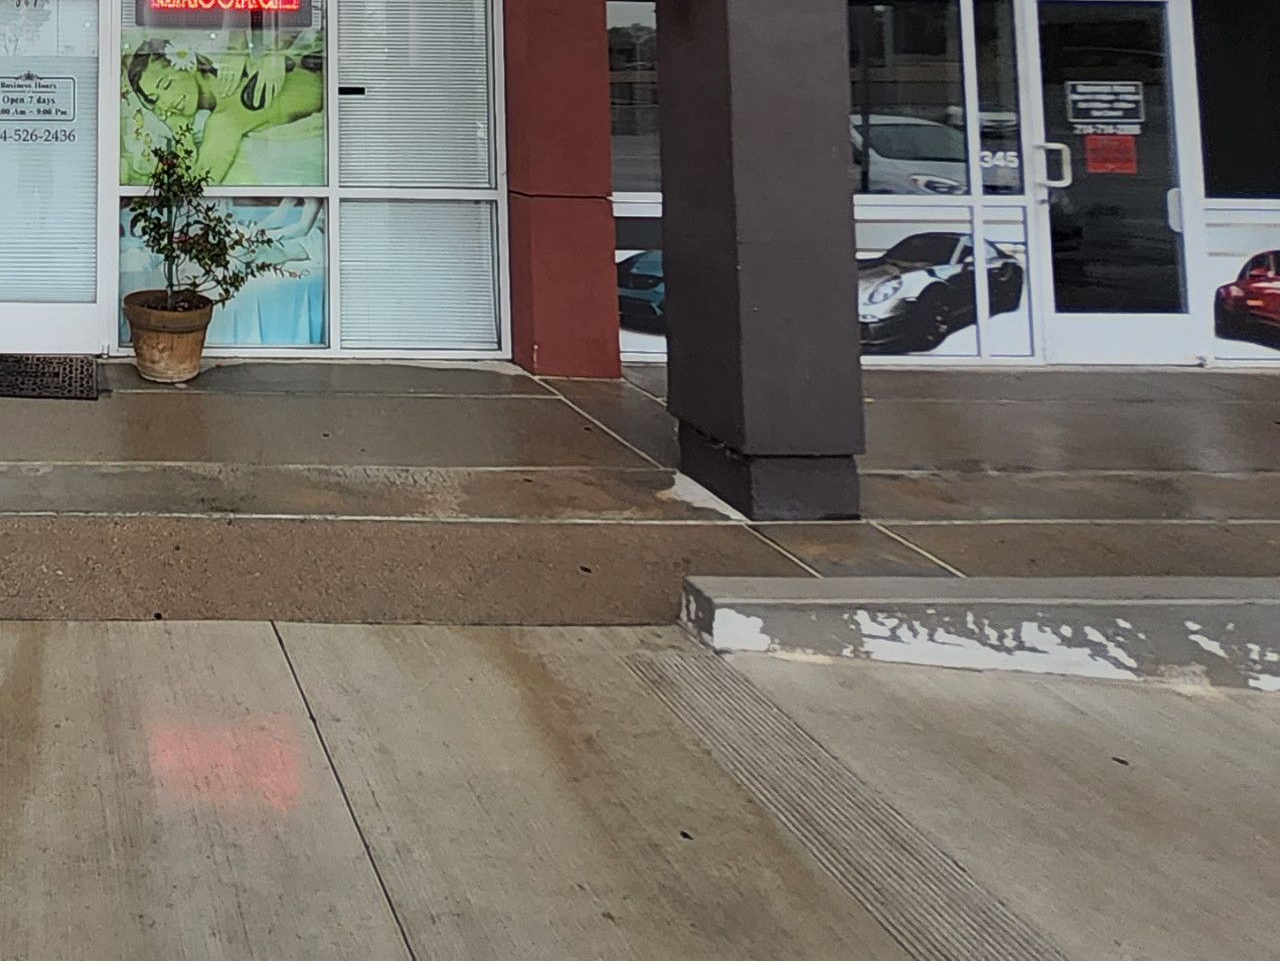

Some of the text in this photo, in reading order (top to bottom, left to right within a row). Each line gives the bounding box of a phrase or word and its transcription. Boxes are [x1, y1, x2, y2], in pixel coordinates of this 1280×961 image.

[2, 95, 56, 105] Open 7 days
[979, 151, 1019, 168] 345
